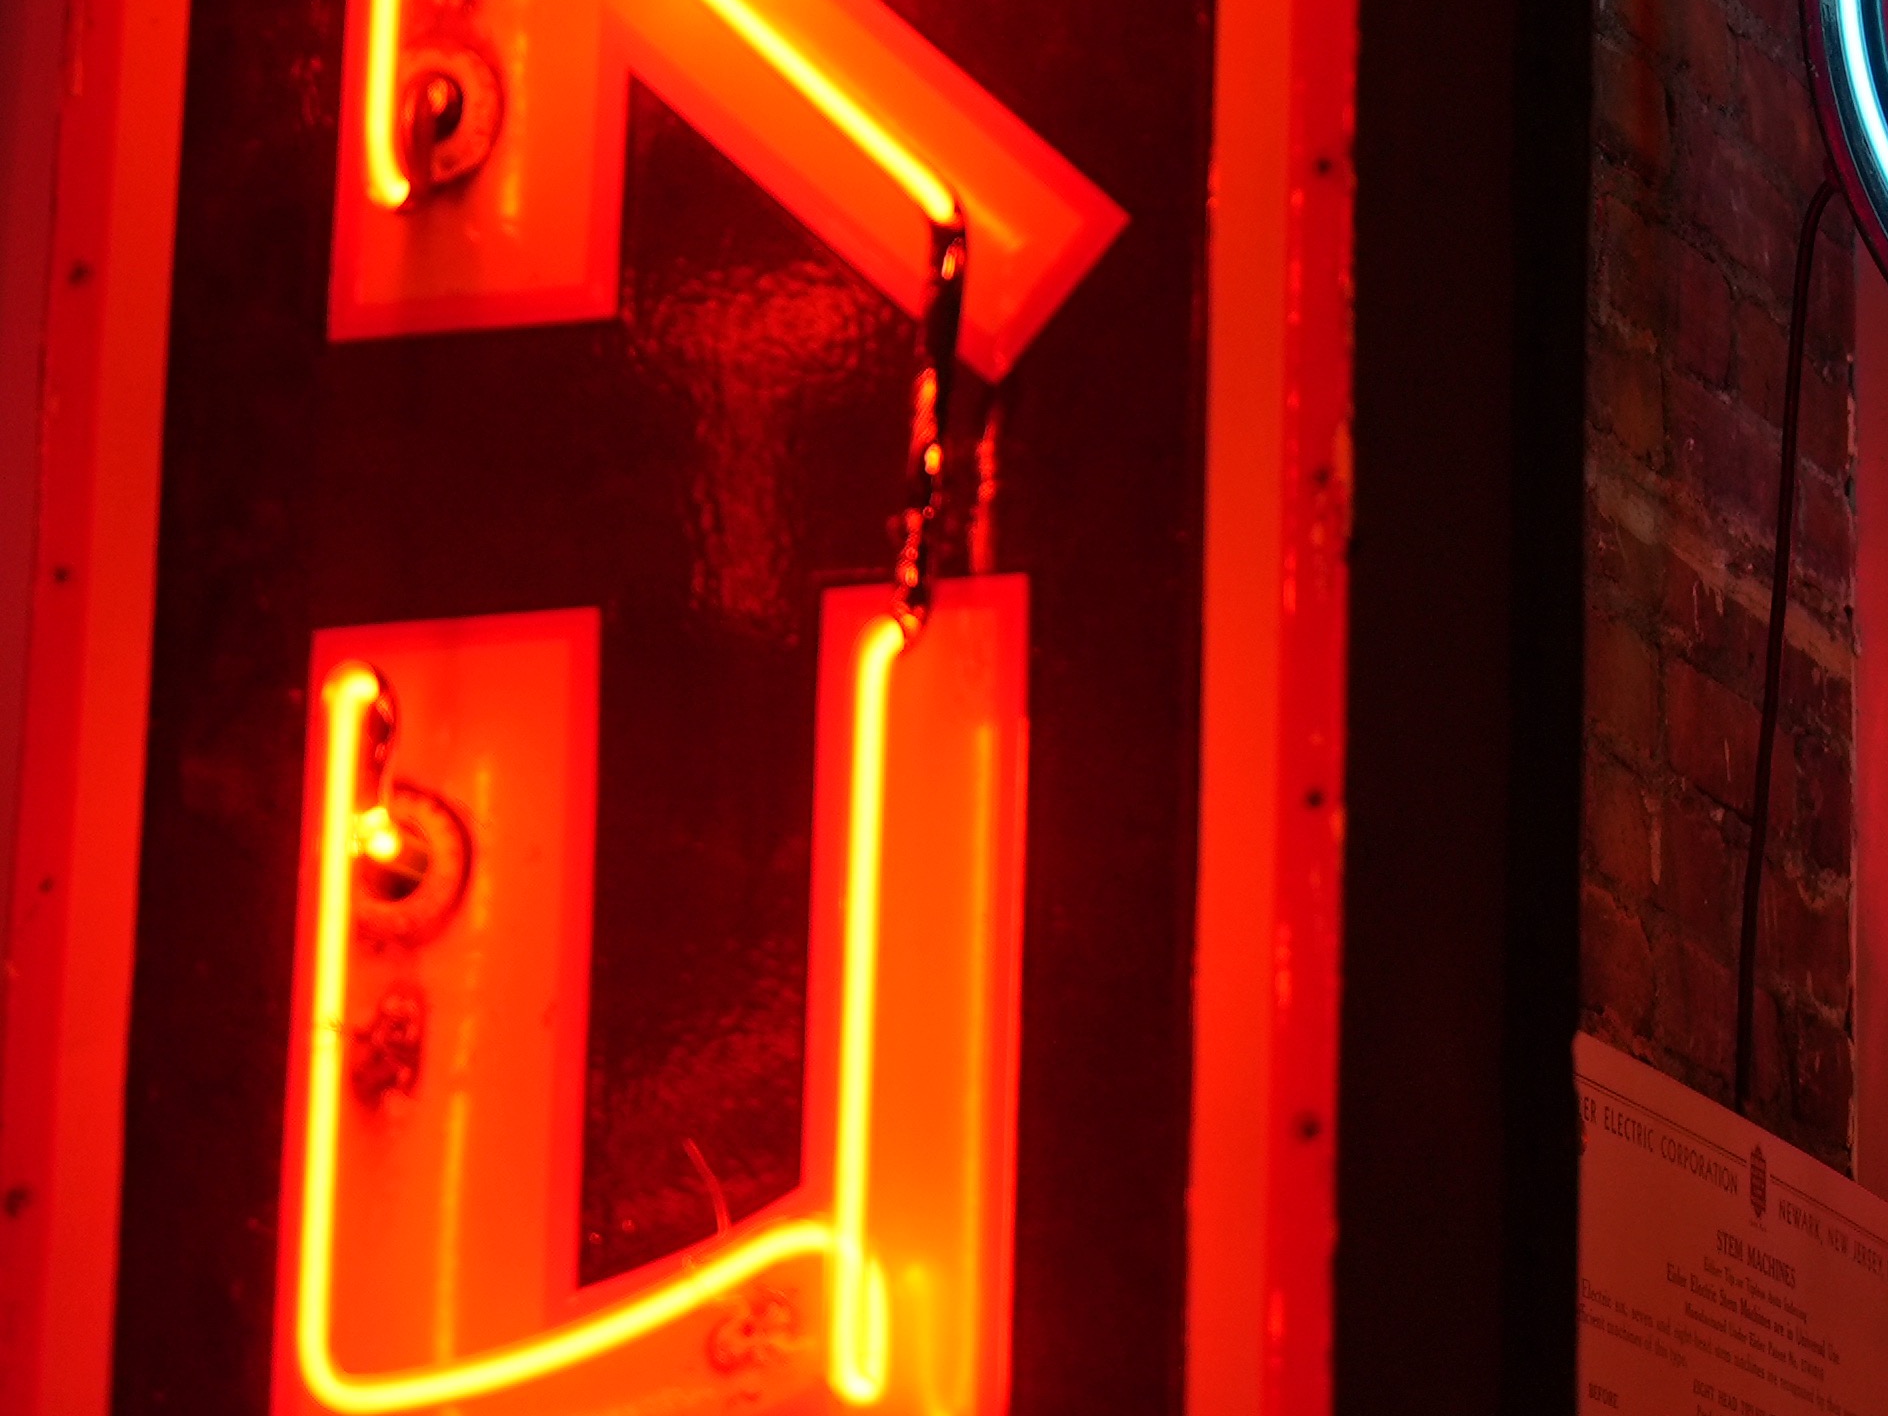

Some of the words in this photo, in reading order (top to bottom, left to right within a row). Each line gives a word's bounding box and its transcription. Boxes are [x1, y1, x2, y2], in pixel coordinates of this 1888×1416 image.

[1604, 1105, 1654, 1153] ELECTRIC
[1661, 1135, 1738, 1195] CORPORATION
[1747, 1244, 1796, 1290] MACHINES
